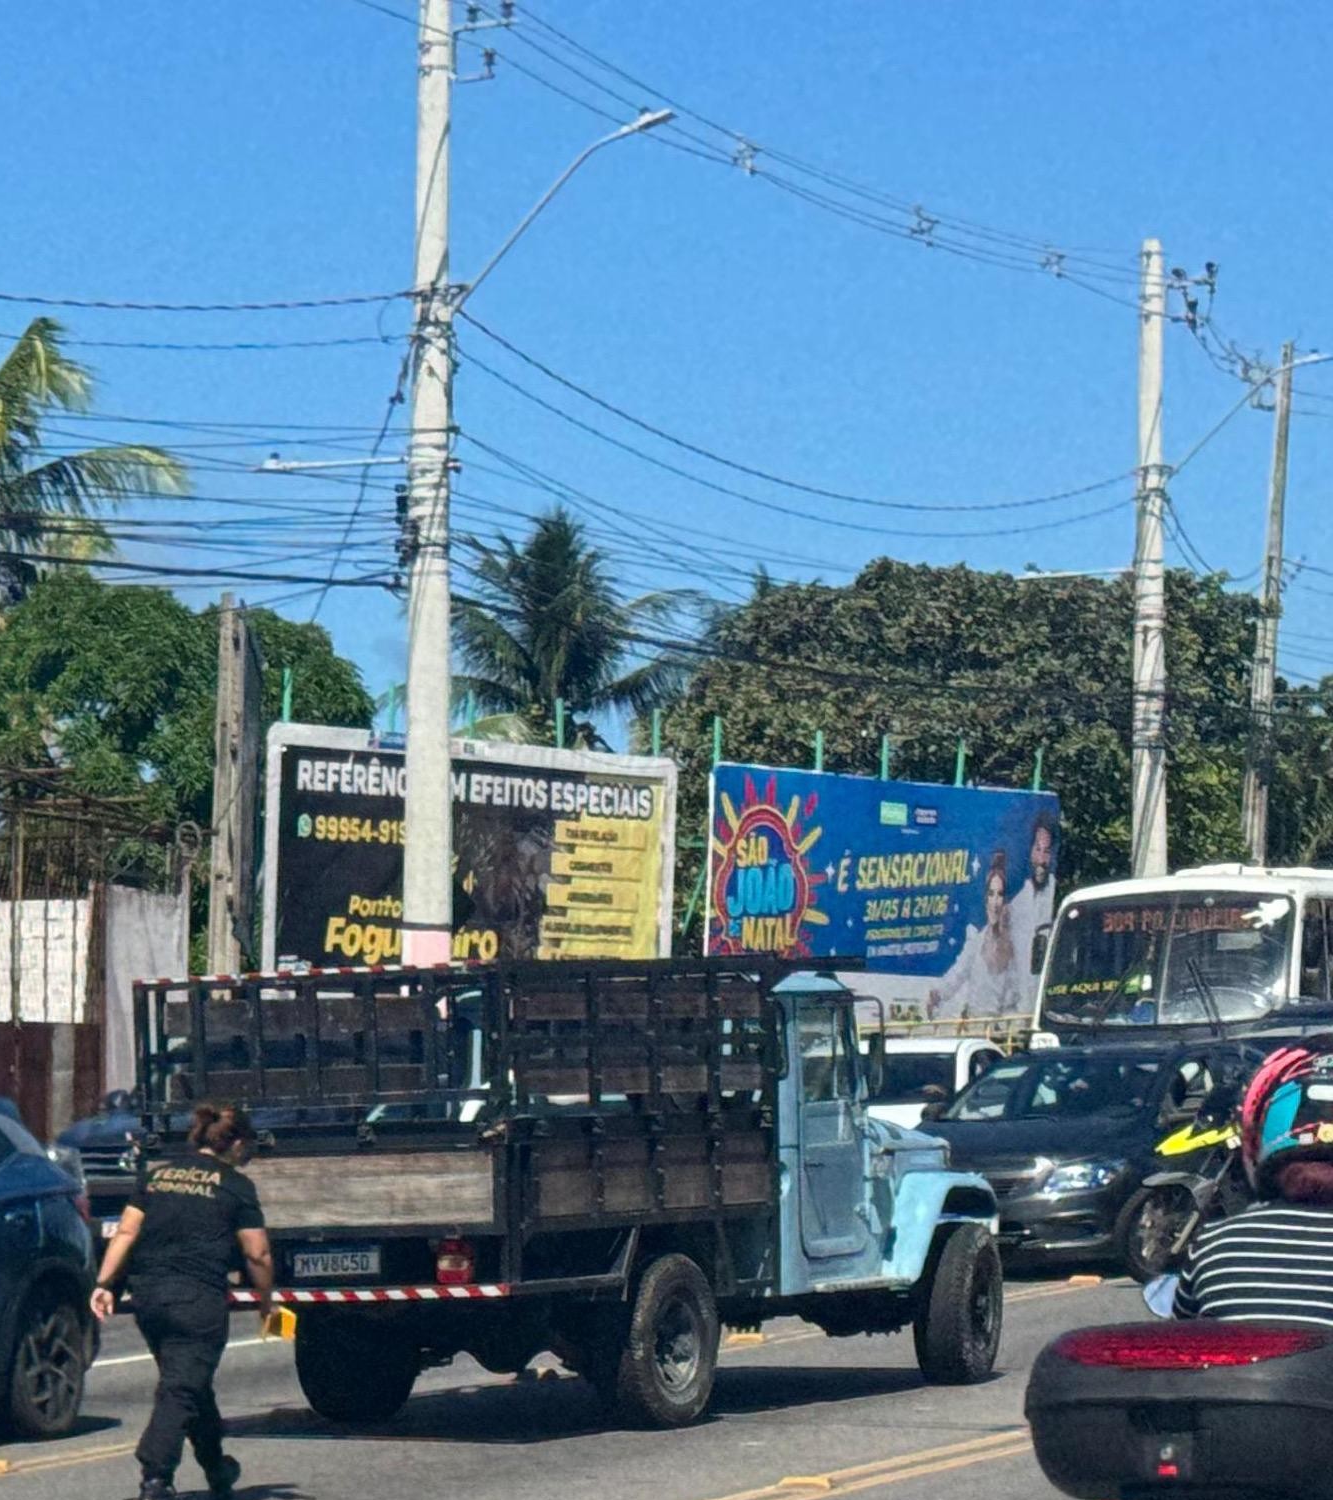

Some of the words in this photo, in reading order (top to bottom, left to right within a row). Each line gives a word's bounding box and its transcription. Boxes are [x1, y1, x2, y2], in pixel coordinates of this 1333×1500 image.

[297, 757, 407, 797] REFERÊNC
[469, 774, 548, 810] EFEITOS
[551, 781, 652, 818] ESPECIAIS
[315, 814, 406, 845] 99954-91
[737, 832, 769, 868] SÃO
[727, 858, 795, 918] JOÃO
[837, 849, 852, 893] É
[855, 849, 972, 891] SENSACIONAL
[349, 895, 403, 918] Ponto
[742, 913, 797, 952] NATAL
